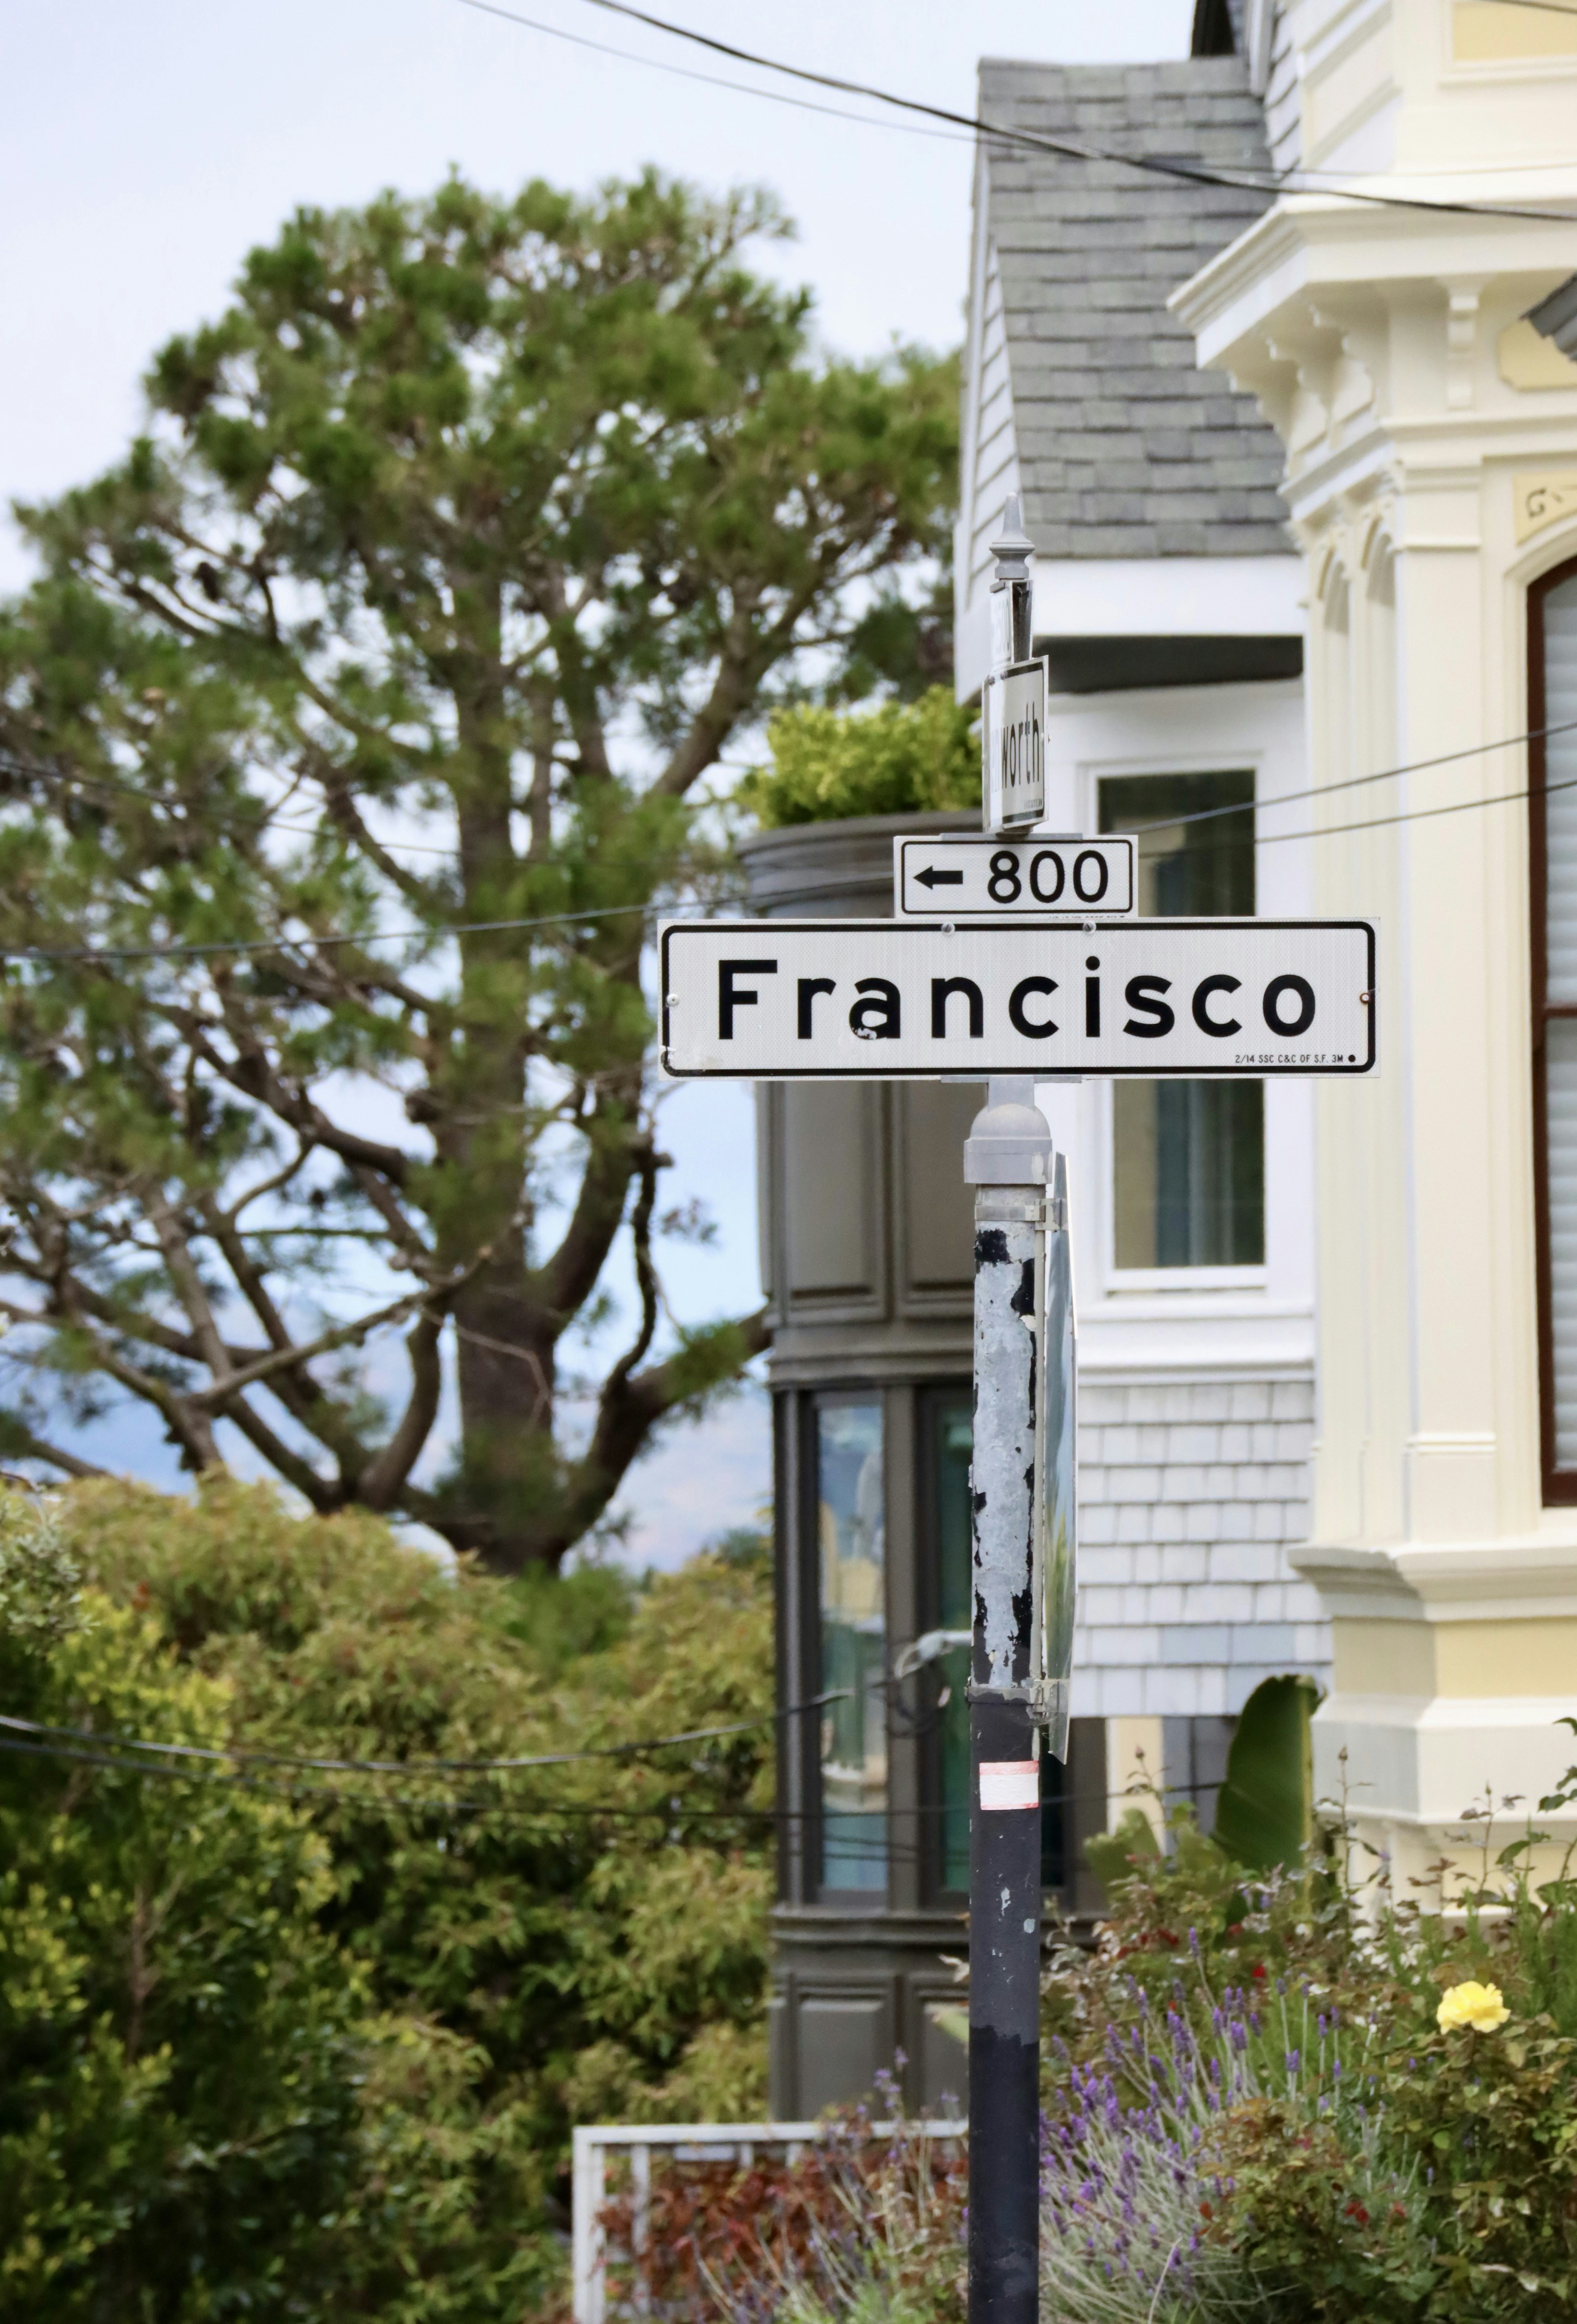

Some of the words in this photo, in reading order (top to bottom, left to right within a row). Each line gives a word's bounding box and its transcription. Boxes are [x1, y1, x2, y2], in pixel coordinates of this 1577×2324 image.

[987, 849, 1108, 904] 800
[719, 956, 1316, 1040] Francisco
[1235, 1054, 1255, 1063] 2/14
[1258, 1054, 1274, 1063] SSC
[1278, 1054, 1296, 1063] C&C
[1300, 1054, 1311, 1063] OF
[1314, 1054, 1328, 1063] S.F.
[1332, 1054, 1343, 1063] 3M
